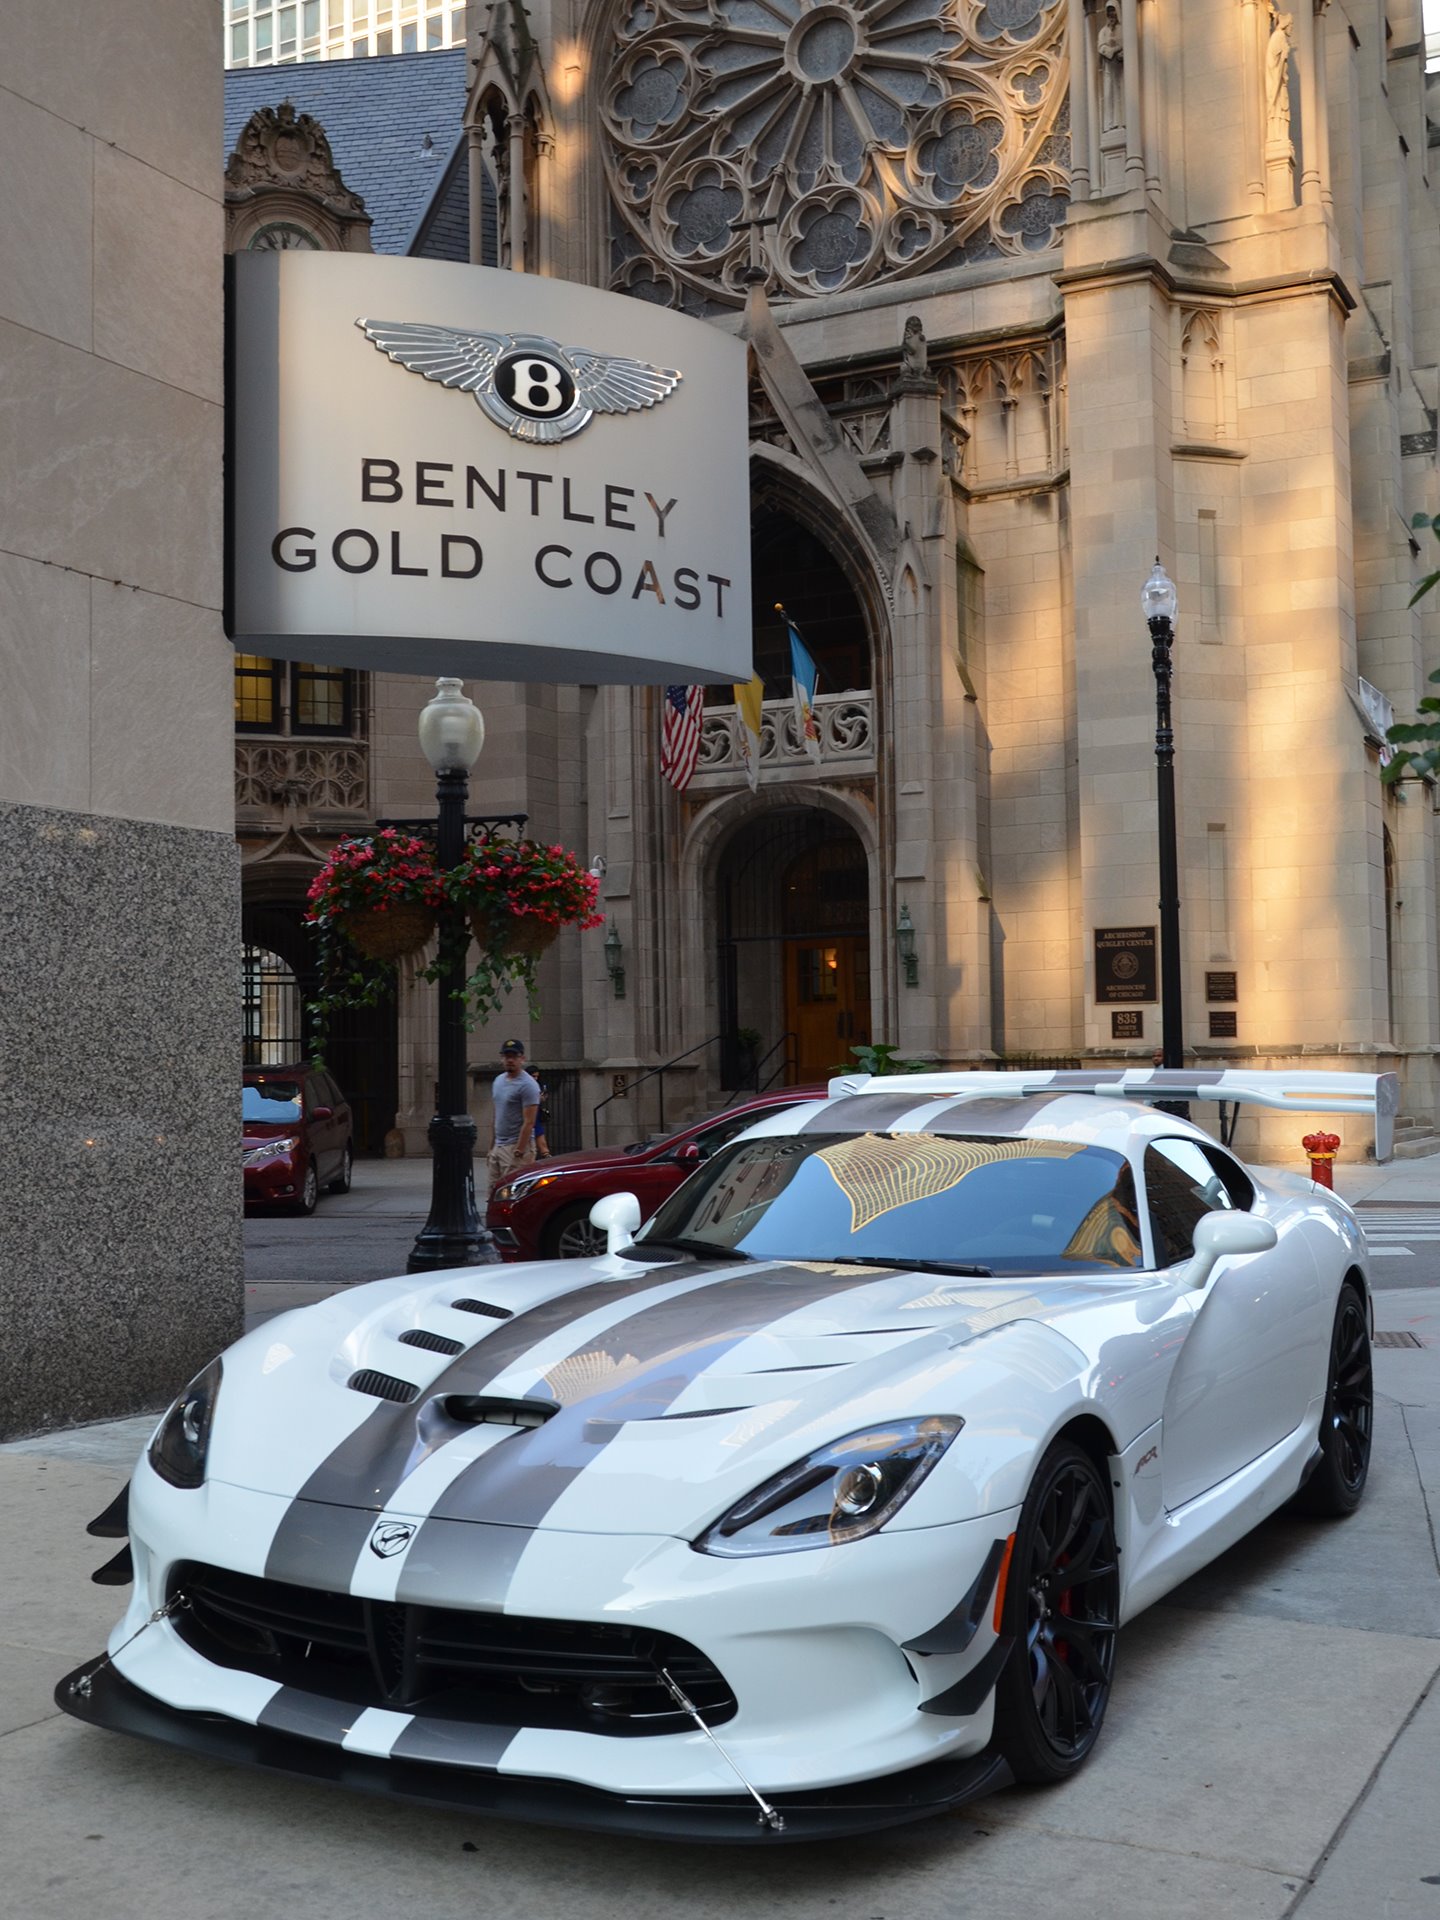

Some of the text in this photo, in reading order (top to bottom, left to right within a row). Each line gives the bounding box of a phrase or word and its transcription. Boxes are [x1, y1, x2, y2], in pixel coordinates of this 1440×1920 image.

[510, 358, 563, 412] B
[360, 458, 678, 537] BENTLEY
[271, 526, 731, 618] GOLD COAST
[1097, 940, 1125, 949] QUIGLEY
[1104, 931, 1146, 939] ARCHBISHOP
[1117, 1013, 1137, 1025] 835
